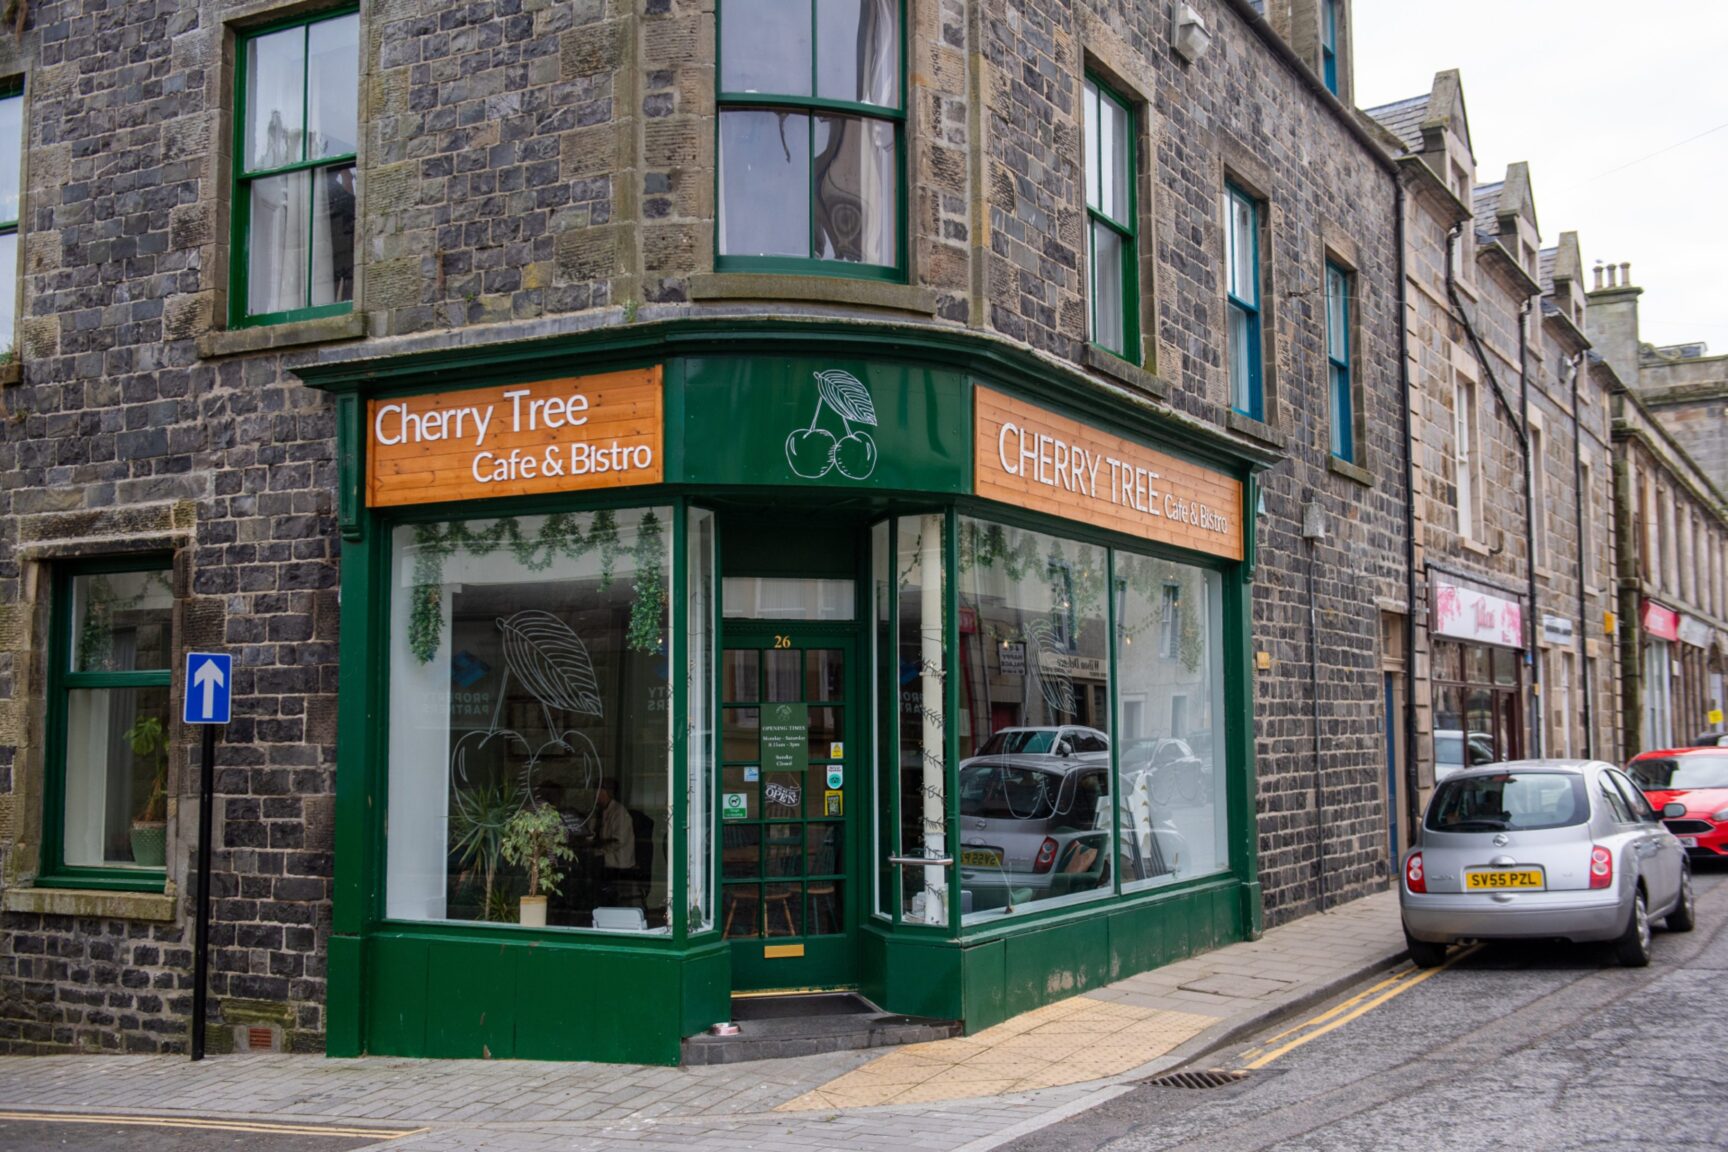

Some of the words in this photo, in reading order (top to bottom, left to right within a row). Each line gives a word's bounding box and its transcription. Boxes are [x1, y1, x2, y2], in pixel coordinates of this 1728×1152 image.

[375, 402, 494, 446] Cherry
[503, 389, 589, 433] Tree
[472, 451, 537, 483] Cafe
[541, 445, 564, 477] &
[571, 442, 652, 476] Bistro
[998, 421, 1101, 499] CHERRY
[1105, 456, 1161, 516] TREE
[1164, 493, 1190, 523] Cafe
[1190, 501, 1199, 526] &
[1200, 504, 1228, 534] Bistro
[774, 635, 791, 649] 26
[765, 787, 797, 804] OPEN
[1472, 873, 1506, 887] SV55
[1509, 872, 1537, 886] PZL
